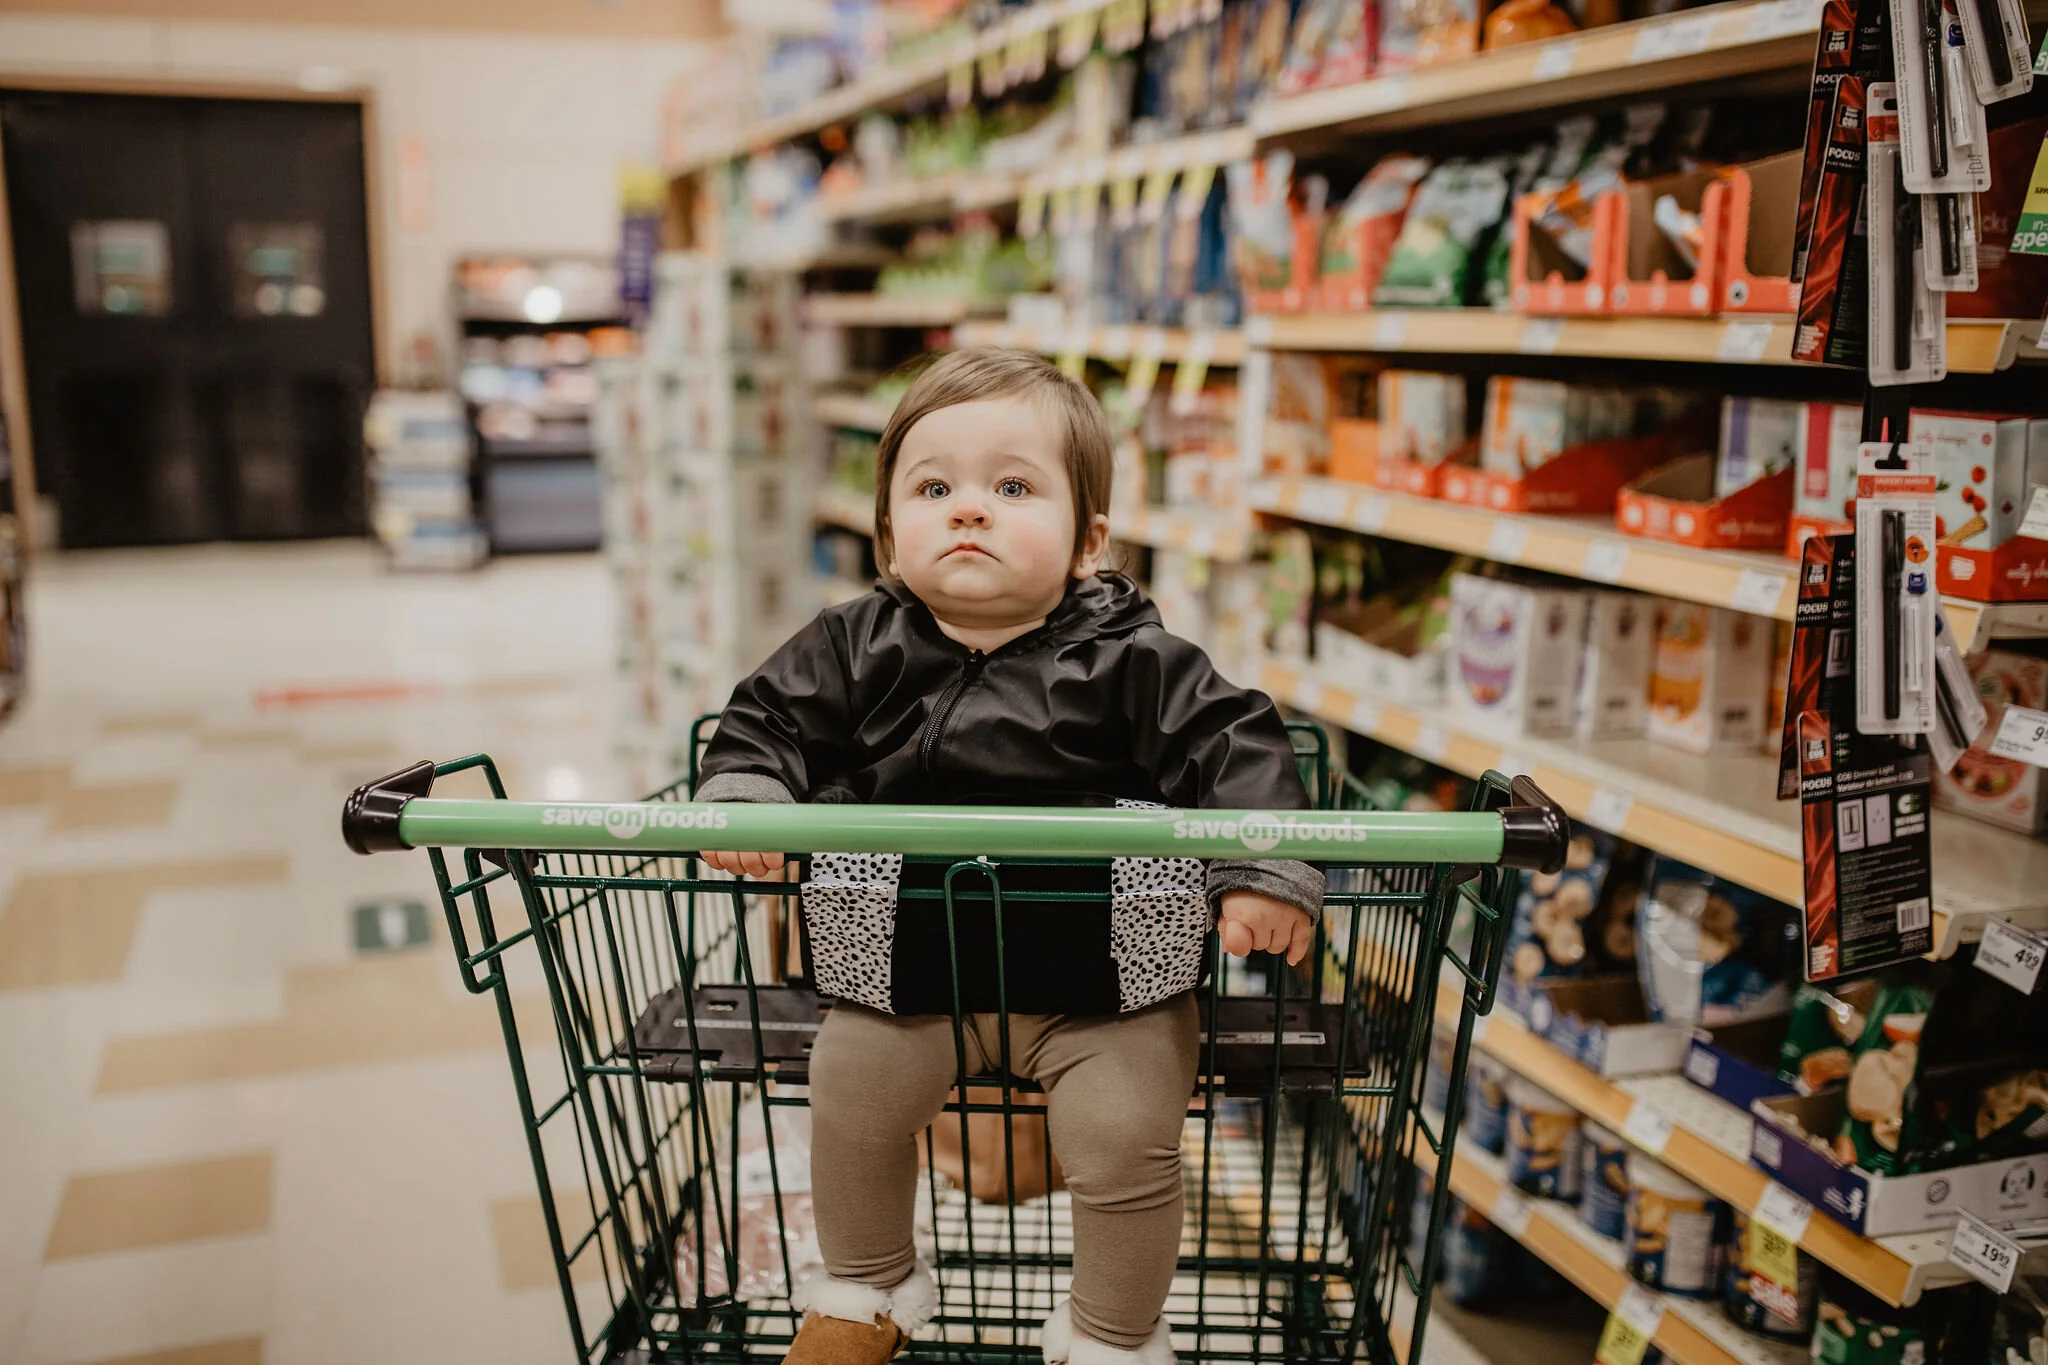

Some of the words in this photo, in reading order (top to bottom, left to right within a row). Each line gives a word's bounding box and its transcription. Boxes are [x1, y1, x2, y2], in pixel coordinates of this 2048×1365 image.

[1828, 147, 1861, 161] FOCUS
[1798, 601, 1829, 615] FOCUS
[1802, 777, 1832, 792] FOCUS
